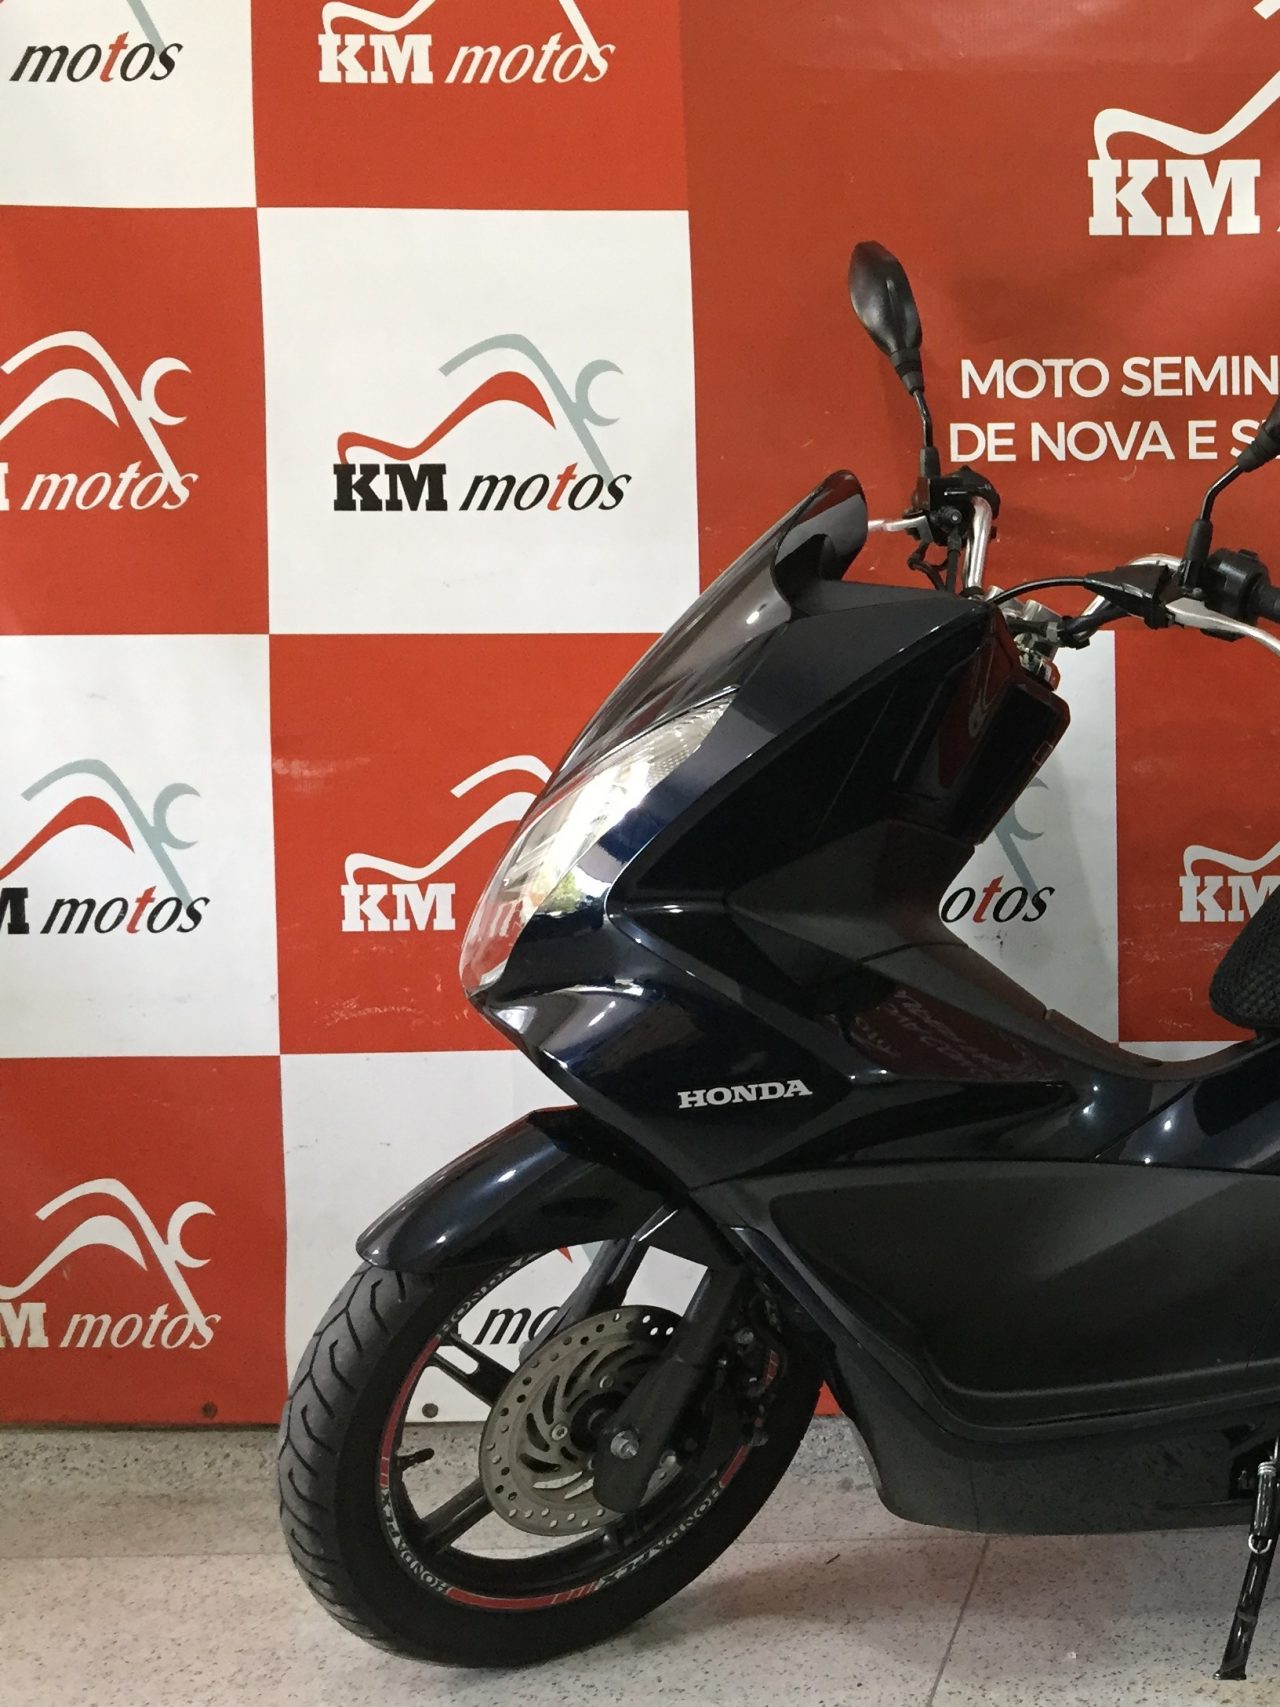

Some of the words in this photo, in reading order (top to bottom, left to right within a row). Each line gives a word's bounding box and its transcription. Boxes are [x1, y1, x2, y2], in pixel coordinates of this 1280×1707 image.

[10, 32, 183, 83] motos
[318, 34, 433, 84] KM
[444, 32, 615, 84] motos
[1088, 158, 1260, 237] KM
[960, 357, 1109, 399] MOTO
[949, 423, 1017, 463] DE
[1030, 420, 1176, 462] NOVA
[1188, 420, 1218, 460] E
[20, 461, 198, 511] motos
[333, 463, 447, 511] KM
[458, 462, 632, 512] motos
[40, 886, 210, 934] motos
[341, 883, 456, 932] KM
[940, 875, 1056, 923] otos
[677, 1079, 813, 1109] HONDA
[0, 1302, 49, 1348] M
[59, 1303, 222, 1350] motos
